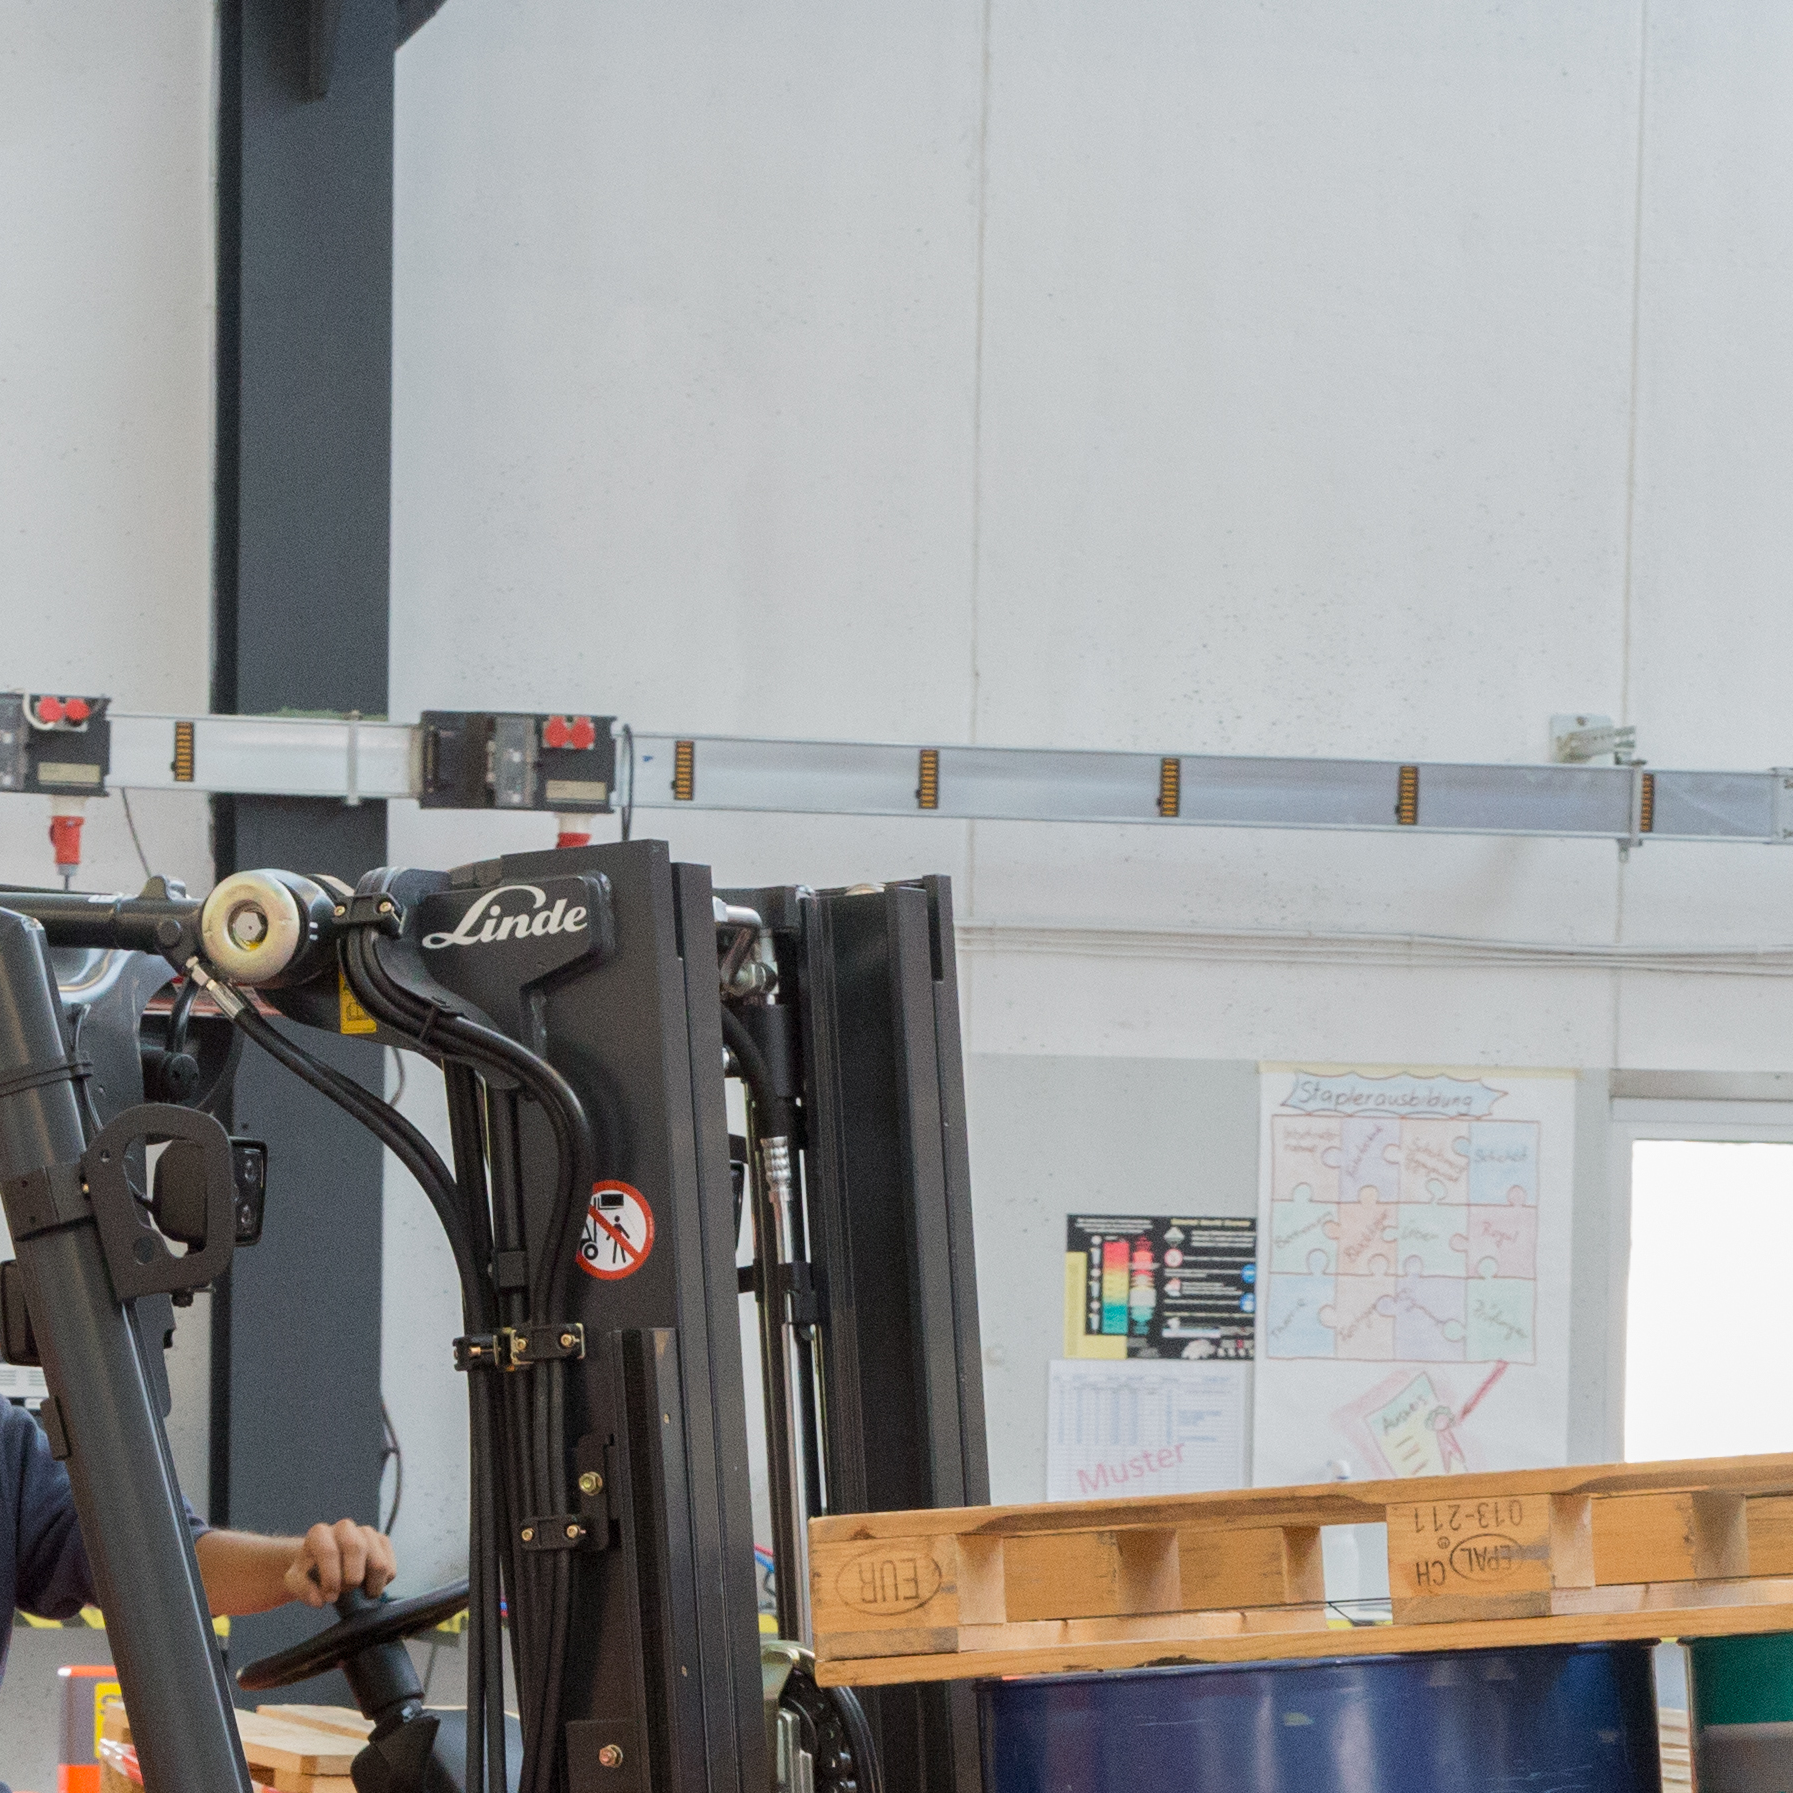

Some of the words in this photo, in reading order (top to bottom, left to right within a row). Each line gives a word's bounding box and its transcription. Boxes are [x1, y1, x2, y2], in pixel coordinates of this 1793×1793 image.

[422, 885, 588, 949] Linde
[1076, 1442, 1186, 1495] Muster
[1413, 1499, 1523, 1533] 013-211
[859, 1557, 922, 1605] EUR
[1460, 1544, 1513, 1574] EPAL
